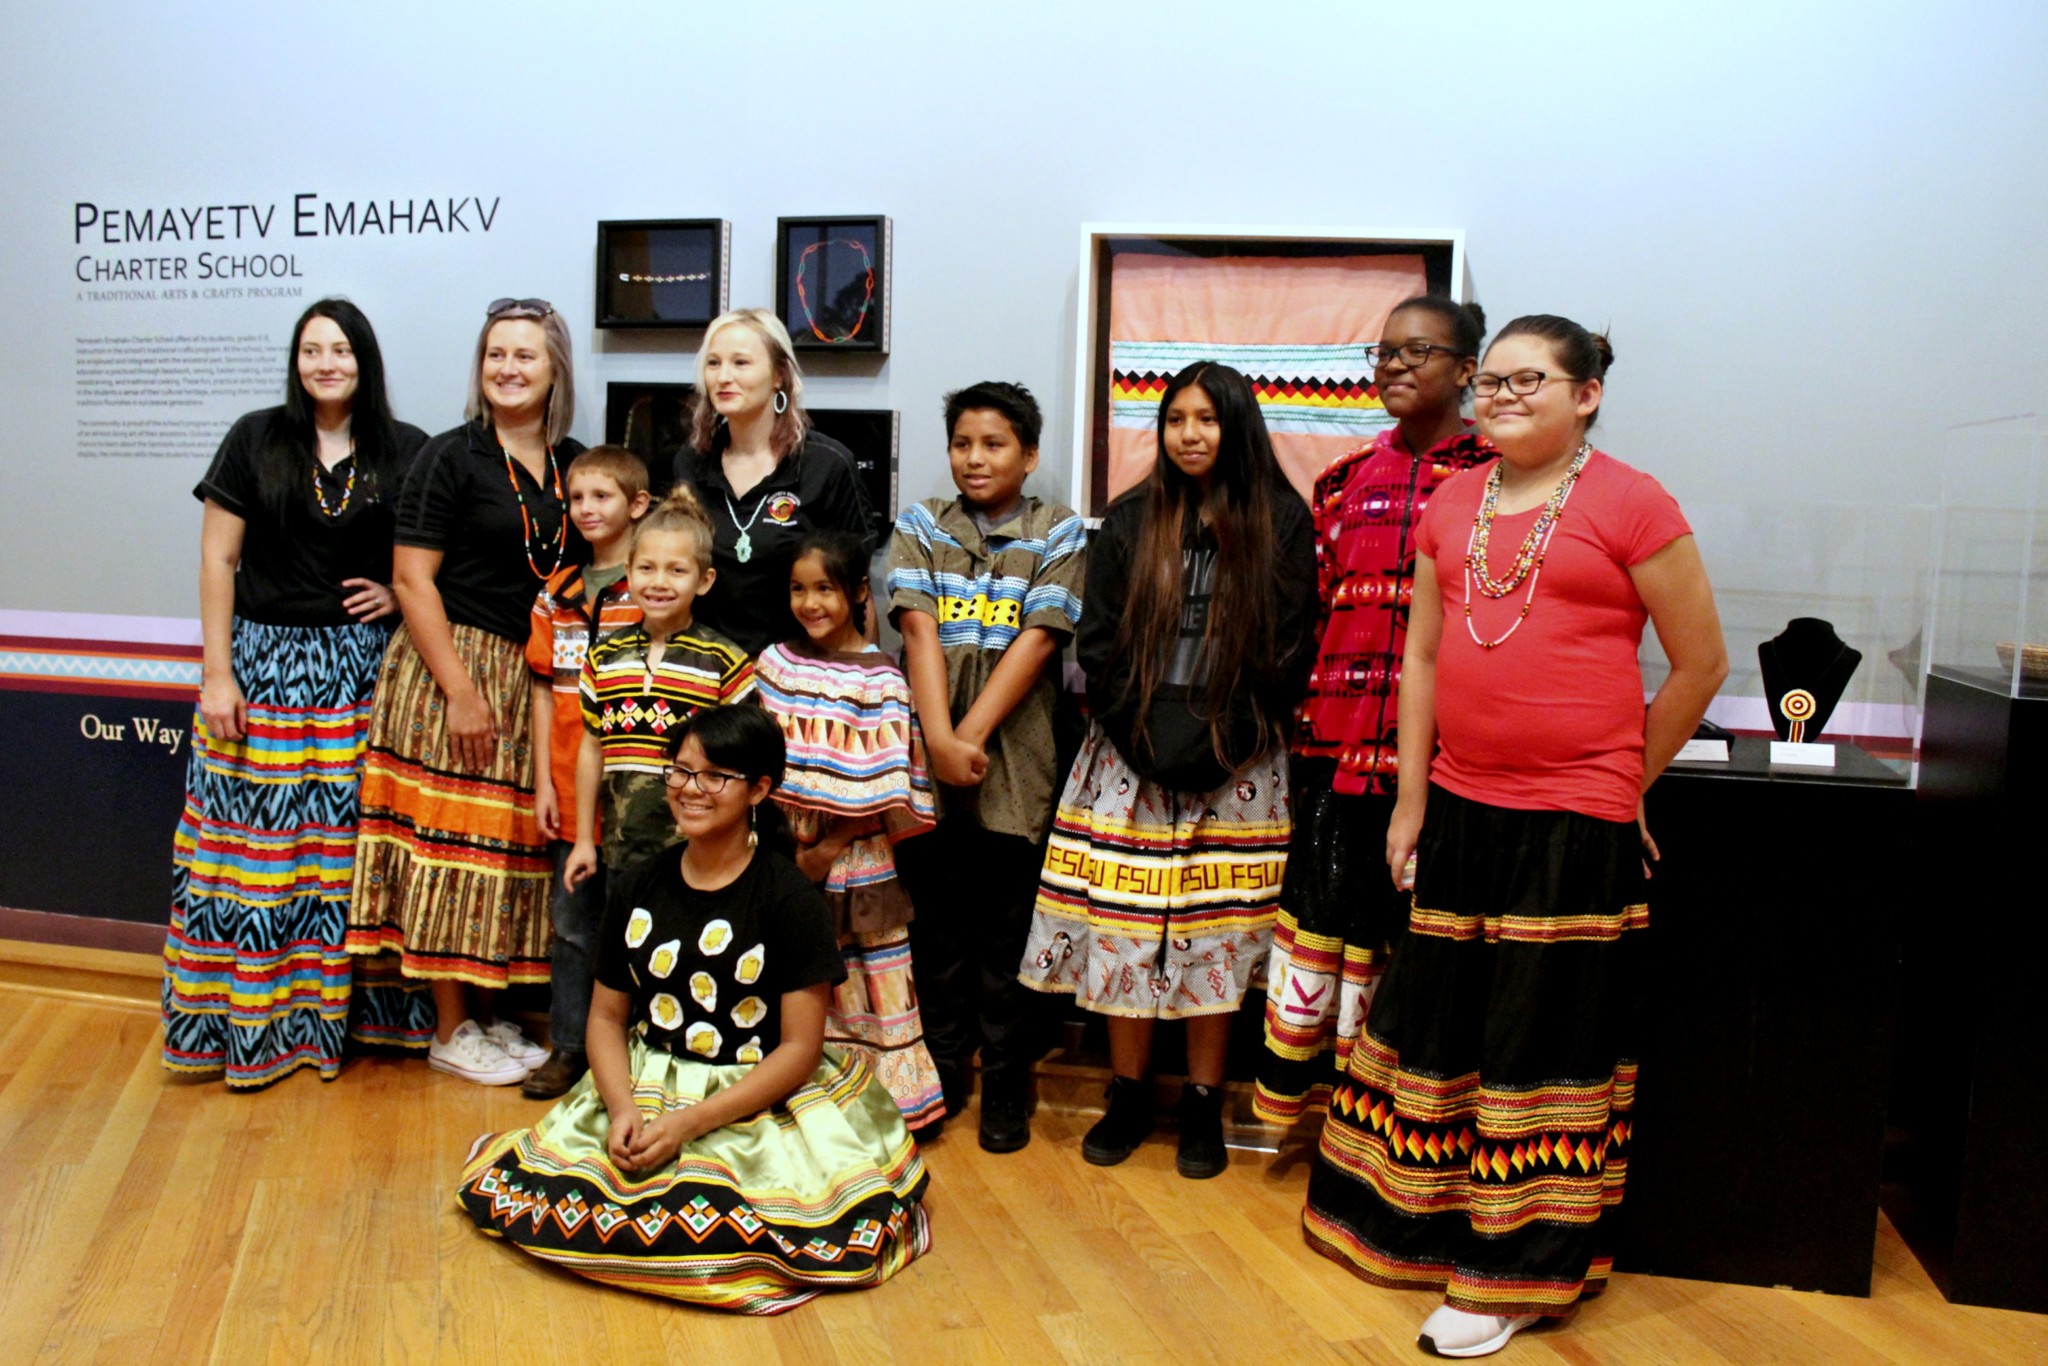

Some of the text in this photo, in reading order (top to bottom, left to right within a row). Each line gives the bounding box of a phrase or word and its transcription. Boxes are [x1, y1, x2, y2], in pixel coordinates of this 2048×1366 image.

[75, 193, 500, 244] PEMAYETV EMAHAKV
[76, 251, 303, 282] CHARTER SCHOOL
[87, 290, 157, 302] TRADITIONAL
[162, 289, 188, 301] ARTS
[191, 289, 199, 300] &
[203, 287, 244, 300] CRAFTS
[247, 286, 303, 299] PROGRAM
[80, 714, 185, 755] Our Way
[1114, 863, 1163, 895] FSU
[1181, 864, 1219, 893] FSU
[1231, 861, 1281, 890] FSU
